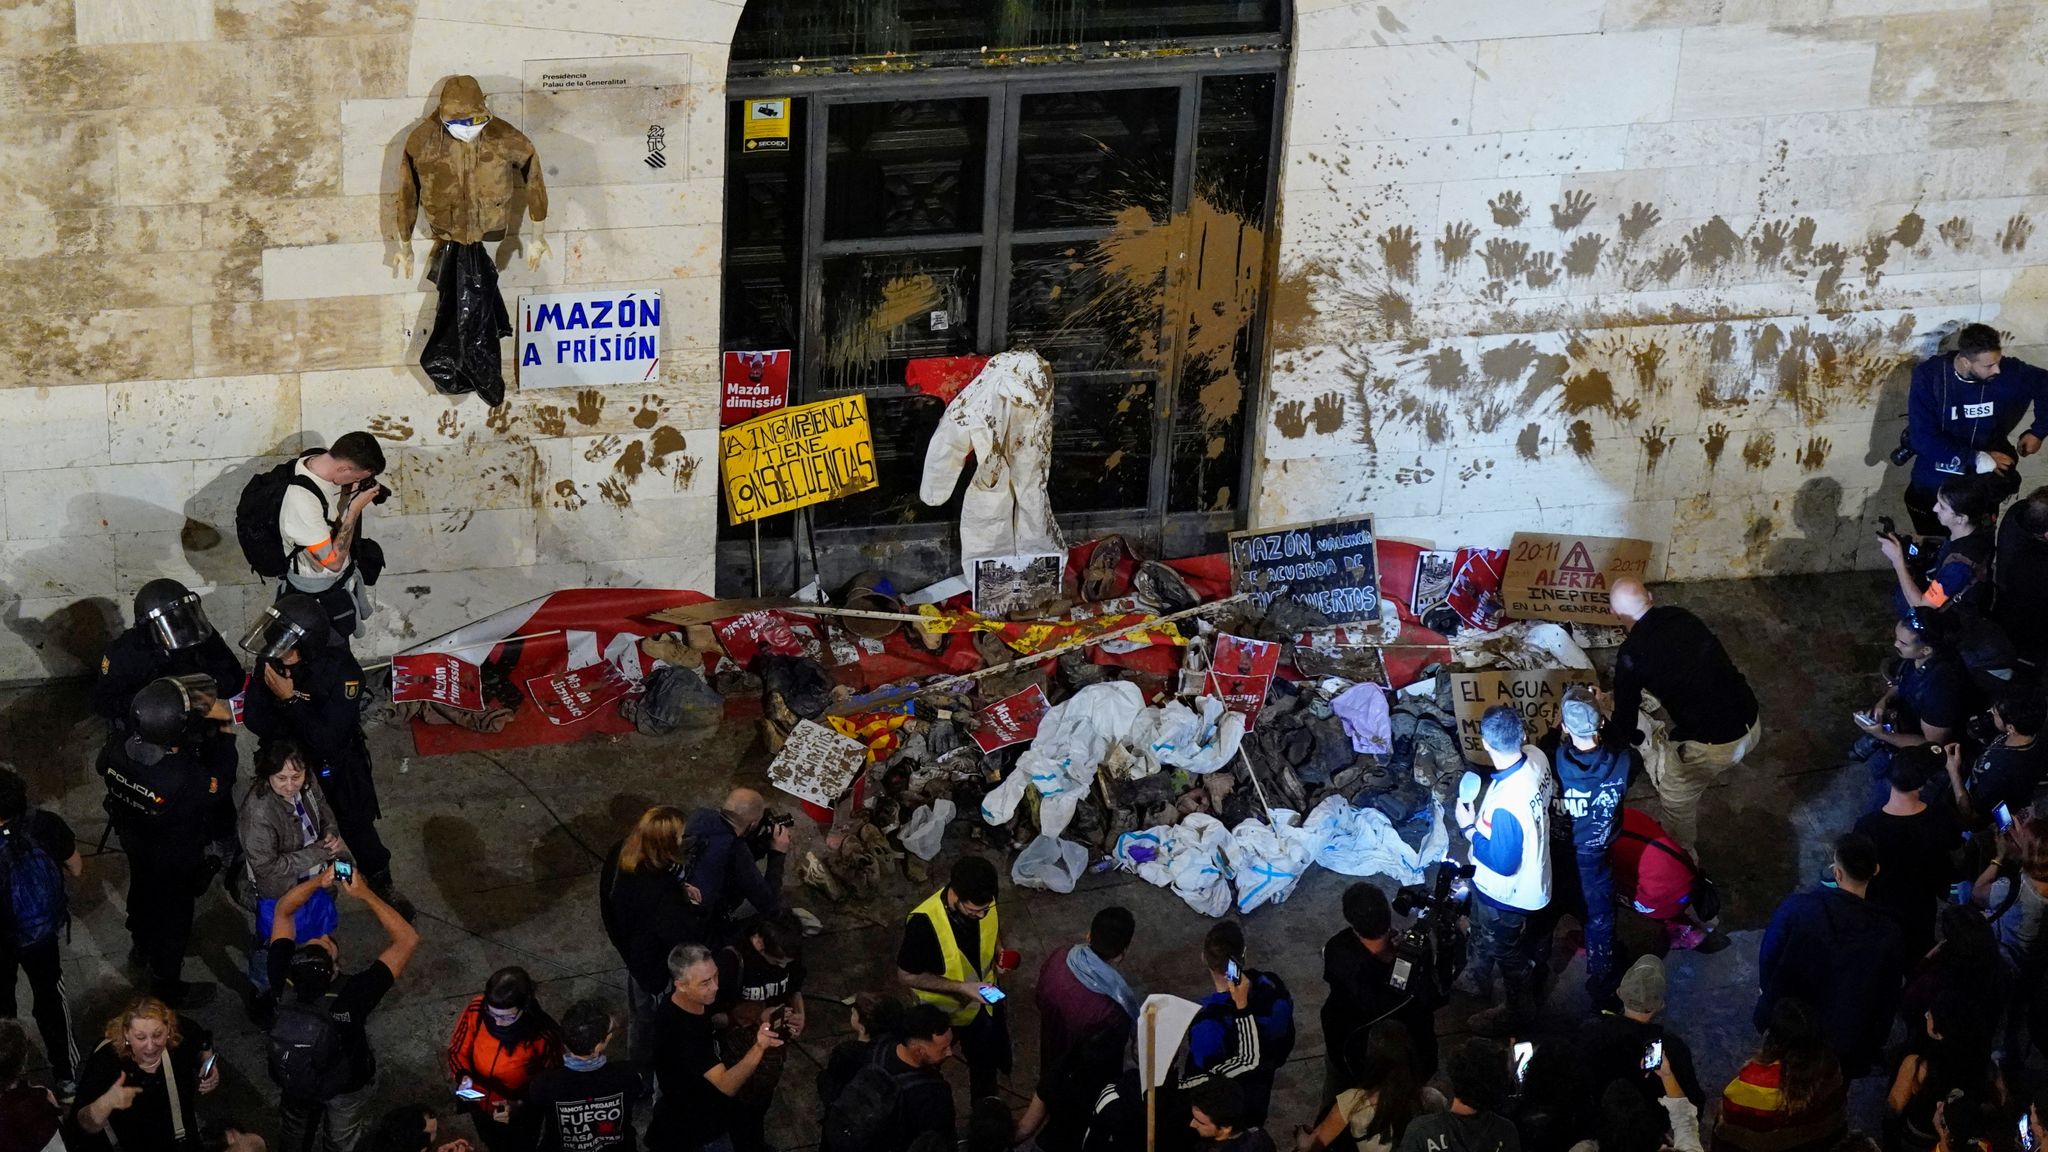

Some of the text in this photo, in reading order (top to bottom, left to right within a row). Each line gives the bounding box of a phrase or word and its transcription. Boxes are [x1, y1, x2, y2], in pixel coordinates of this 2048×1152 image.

[543, 72, 587, 80] Presidència
[585, 78, 627, 86] Generalitat
[526, 293, 661, 332] ¡MAZÓN
[522, 342, 542, 367] A
[727, 383, 770, 395] Mazón
[726, 395, 782, 408] dimissió
[762, 436, 828, 466] TIENE
[728, 440, 875, 516] CONSECUENCIAS
[1514, 541, 1561, 562] 20:11
[1267, 558, 1337, 583] ACUERDA
[1344, 553, 1364, 572] DE
[1610, 558, 1647, 573] 20:11
[1535, 568, 1606, 590] ALERTA
[1512, 602, 1528, 611] EN
[1533, 603, 1551, 612] LA
[564, 673, 592, 704] Maón
[1460, 680, 1485, 702] EL
[1497, 680, 1554, 700] AGUA
[107, 767, 157, 800] POLICIA
[560, 1104, 584, 1113] VAMOS
[560, 1108, 621, 1126] FUEGO
[562, 1132, 594, 1142] CASA
[563, 1123, 591, 1135] A LA
